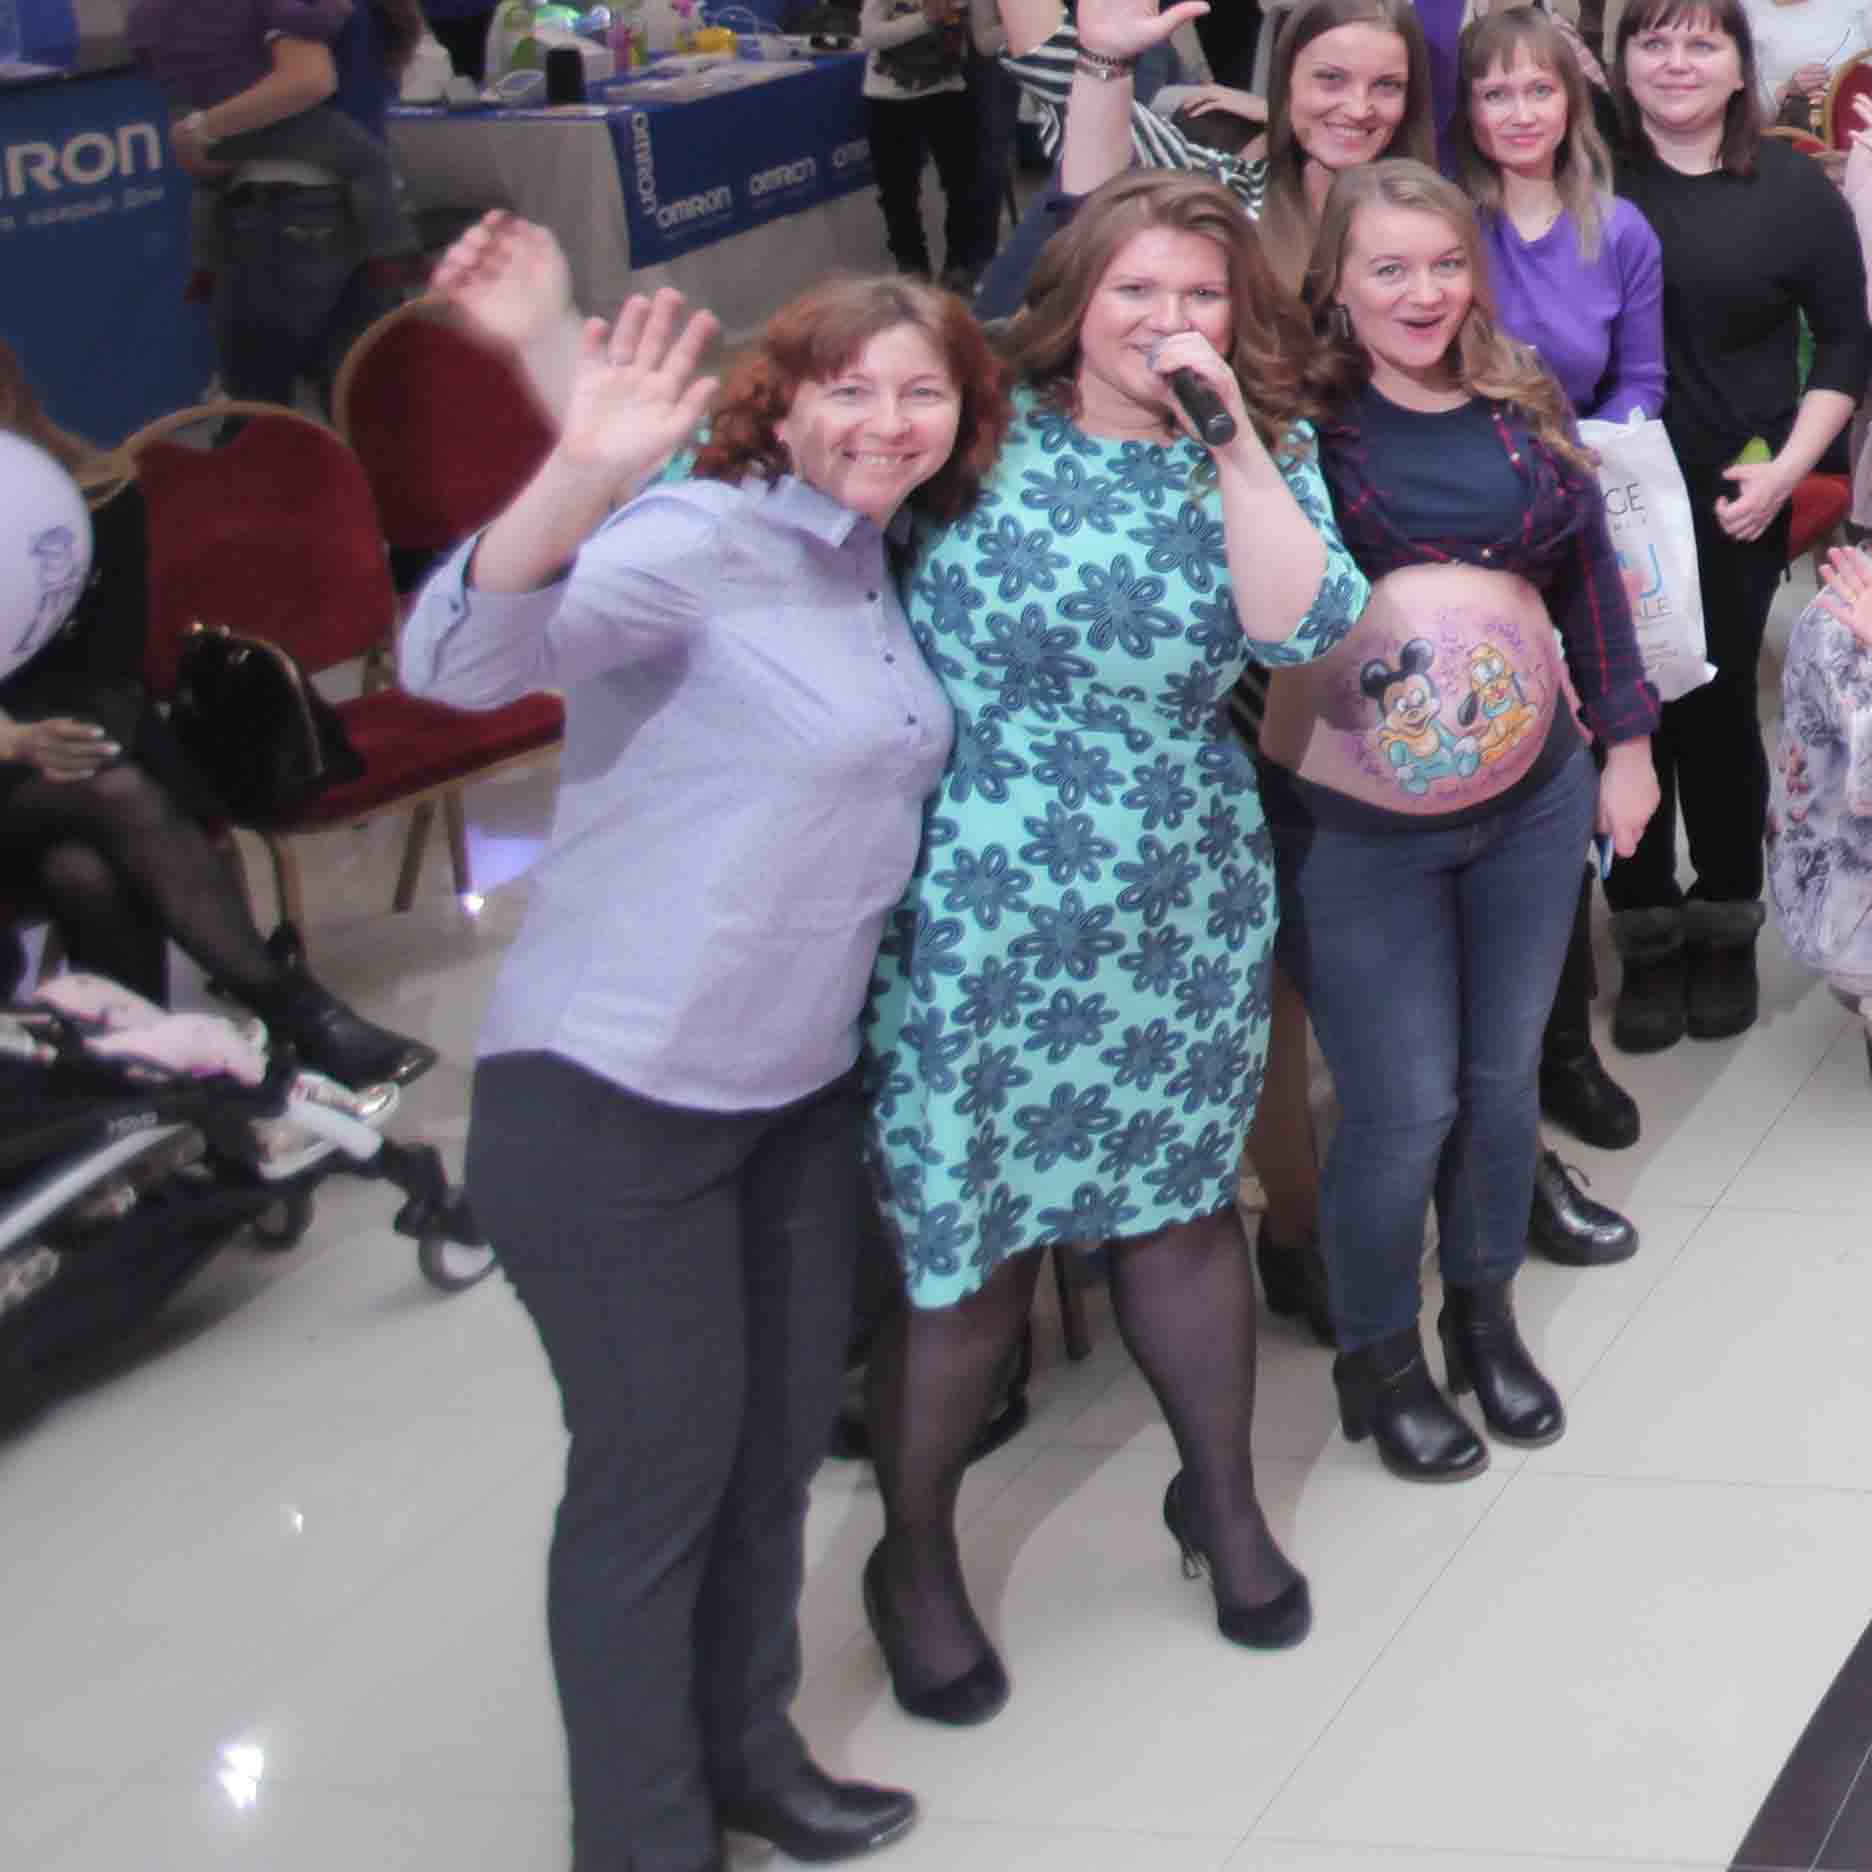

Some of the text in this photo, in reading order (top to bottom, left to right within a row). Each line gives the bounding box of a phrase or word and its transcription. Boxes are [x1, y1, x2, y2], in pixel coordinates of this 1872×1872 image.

[0, 123, 162, 197] RON
[632, 111, 657, 215] OMRON
[656, 185, 733, 228] OMRON
